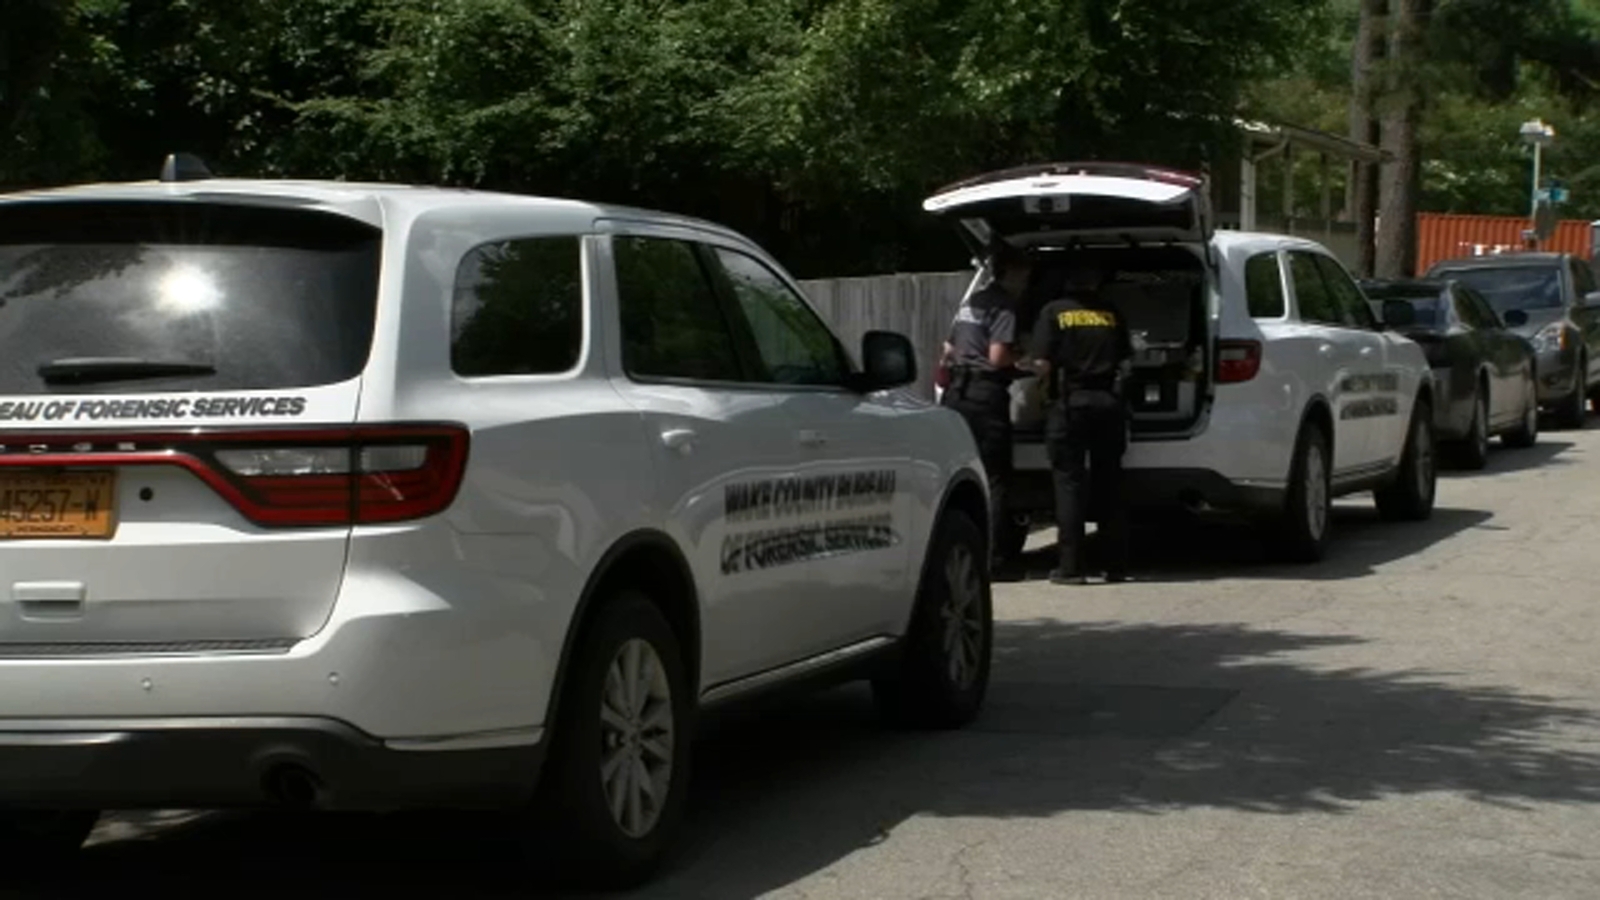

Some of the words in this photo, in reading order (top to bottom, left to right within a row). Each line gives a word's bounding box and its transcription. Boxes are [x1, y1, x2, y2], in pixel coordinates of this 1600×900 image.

[44, 400, 76, 420] OF
[75, 399, 190, 419] FORENSIC
[190, 397, 306, 416] SERVICES
[725, 480, 773, 522] WAKE
[774, 475, 836, 517] COUNTY
[837, 469, 896, 507] BUREAU
[720, 534, 744, 575] OF
[744, 521, 821, 570] FORENSIC
[825, 512, 892, 554] SERVICES
